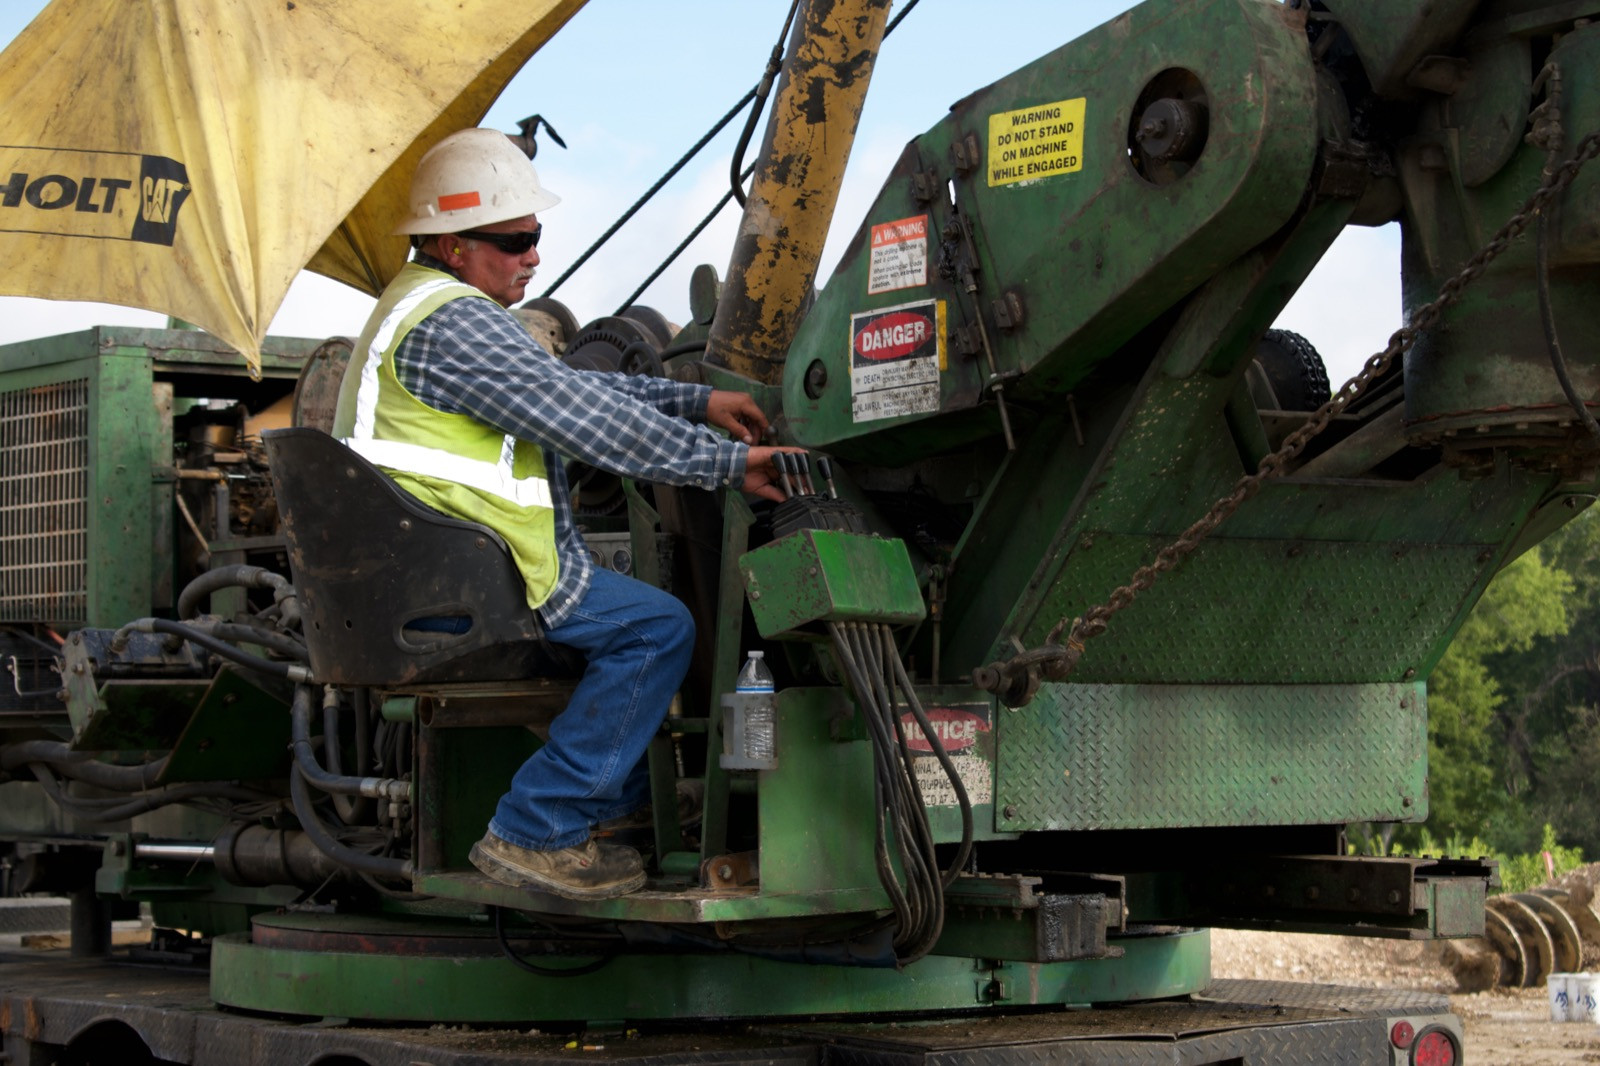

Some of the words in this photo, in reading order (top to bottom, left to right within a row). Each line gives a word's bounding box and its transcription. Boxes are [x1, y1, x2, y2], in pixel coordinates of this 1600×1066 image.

[1012, 108, 1061, 126] WARNING
[998, 134, 1012, 146] DO
[1014, 129, 1036, 143] NOT
[1039, 122, 1074, 138] STAND
[1002, 150, 1017, 162] ON
[1020, 140, 1067, 159] MACHINE
[993, 165, 1024, 180] WHILE
[1027, 156, 1077, 174] ENGAGED
[0, 173, 132, 213] HOLT
[142, 176, 184, 224] CAT
[884, 221, 924, 240] WARNING
[900, 268, 921, 276] extreme
[862, 321, 926, 352] DANGER
[864, 374, 881, 384] DEATH
